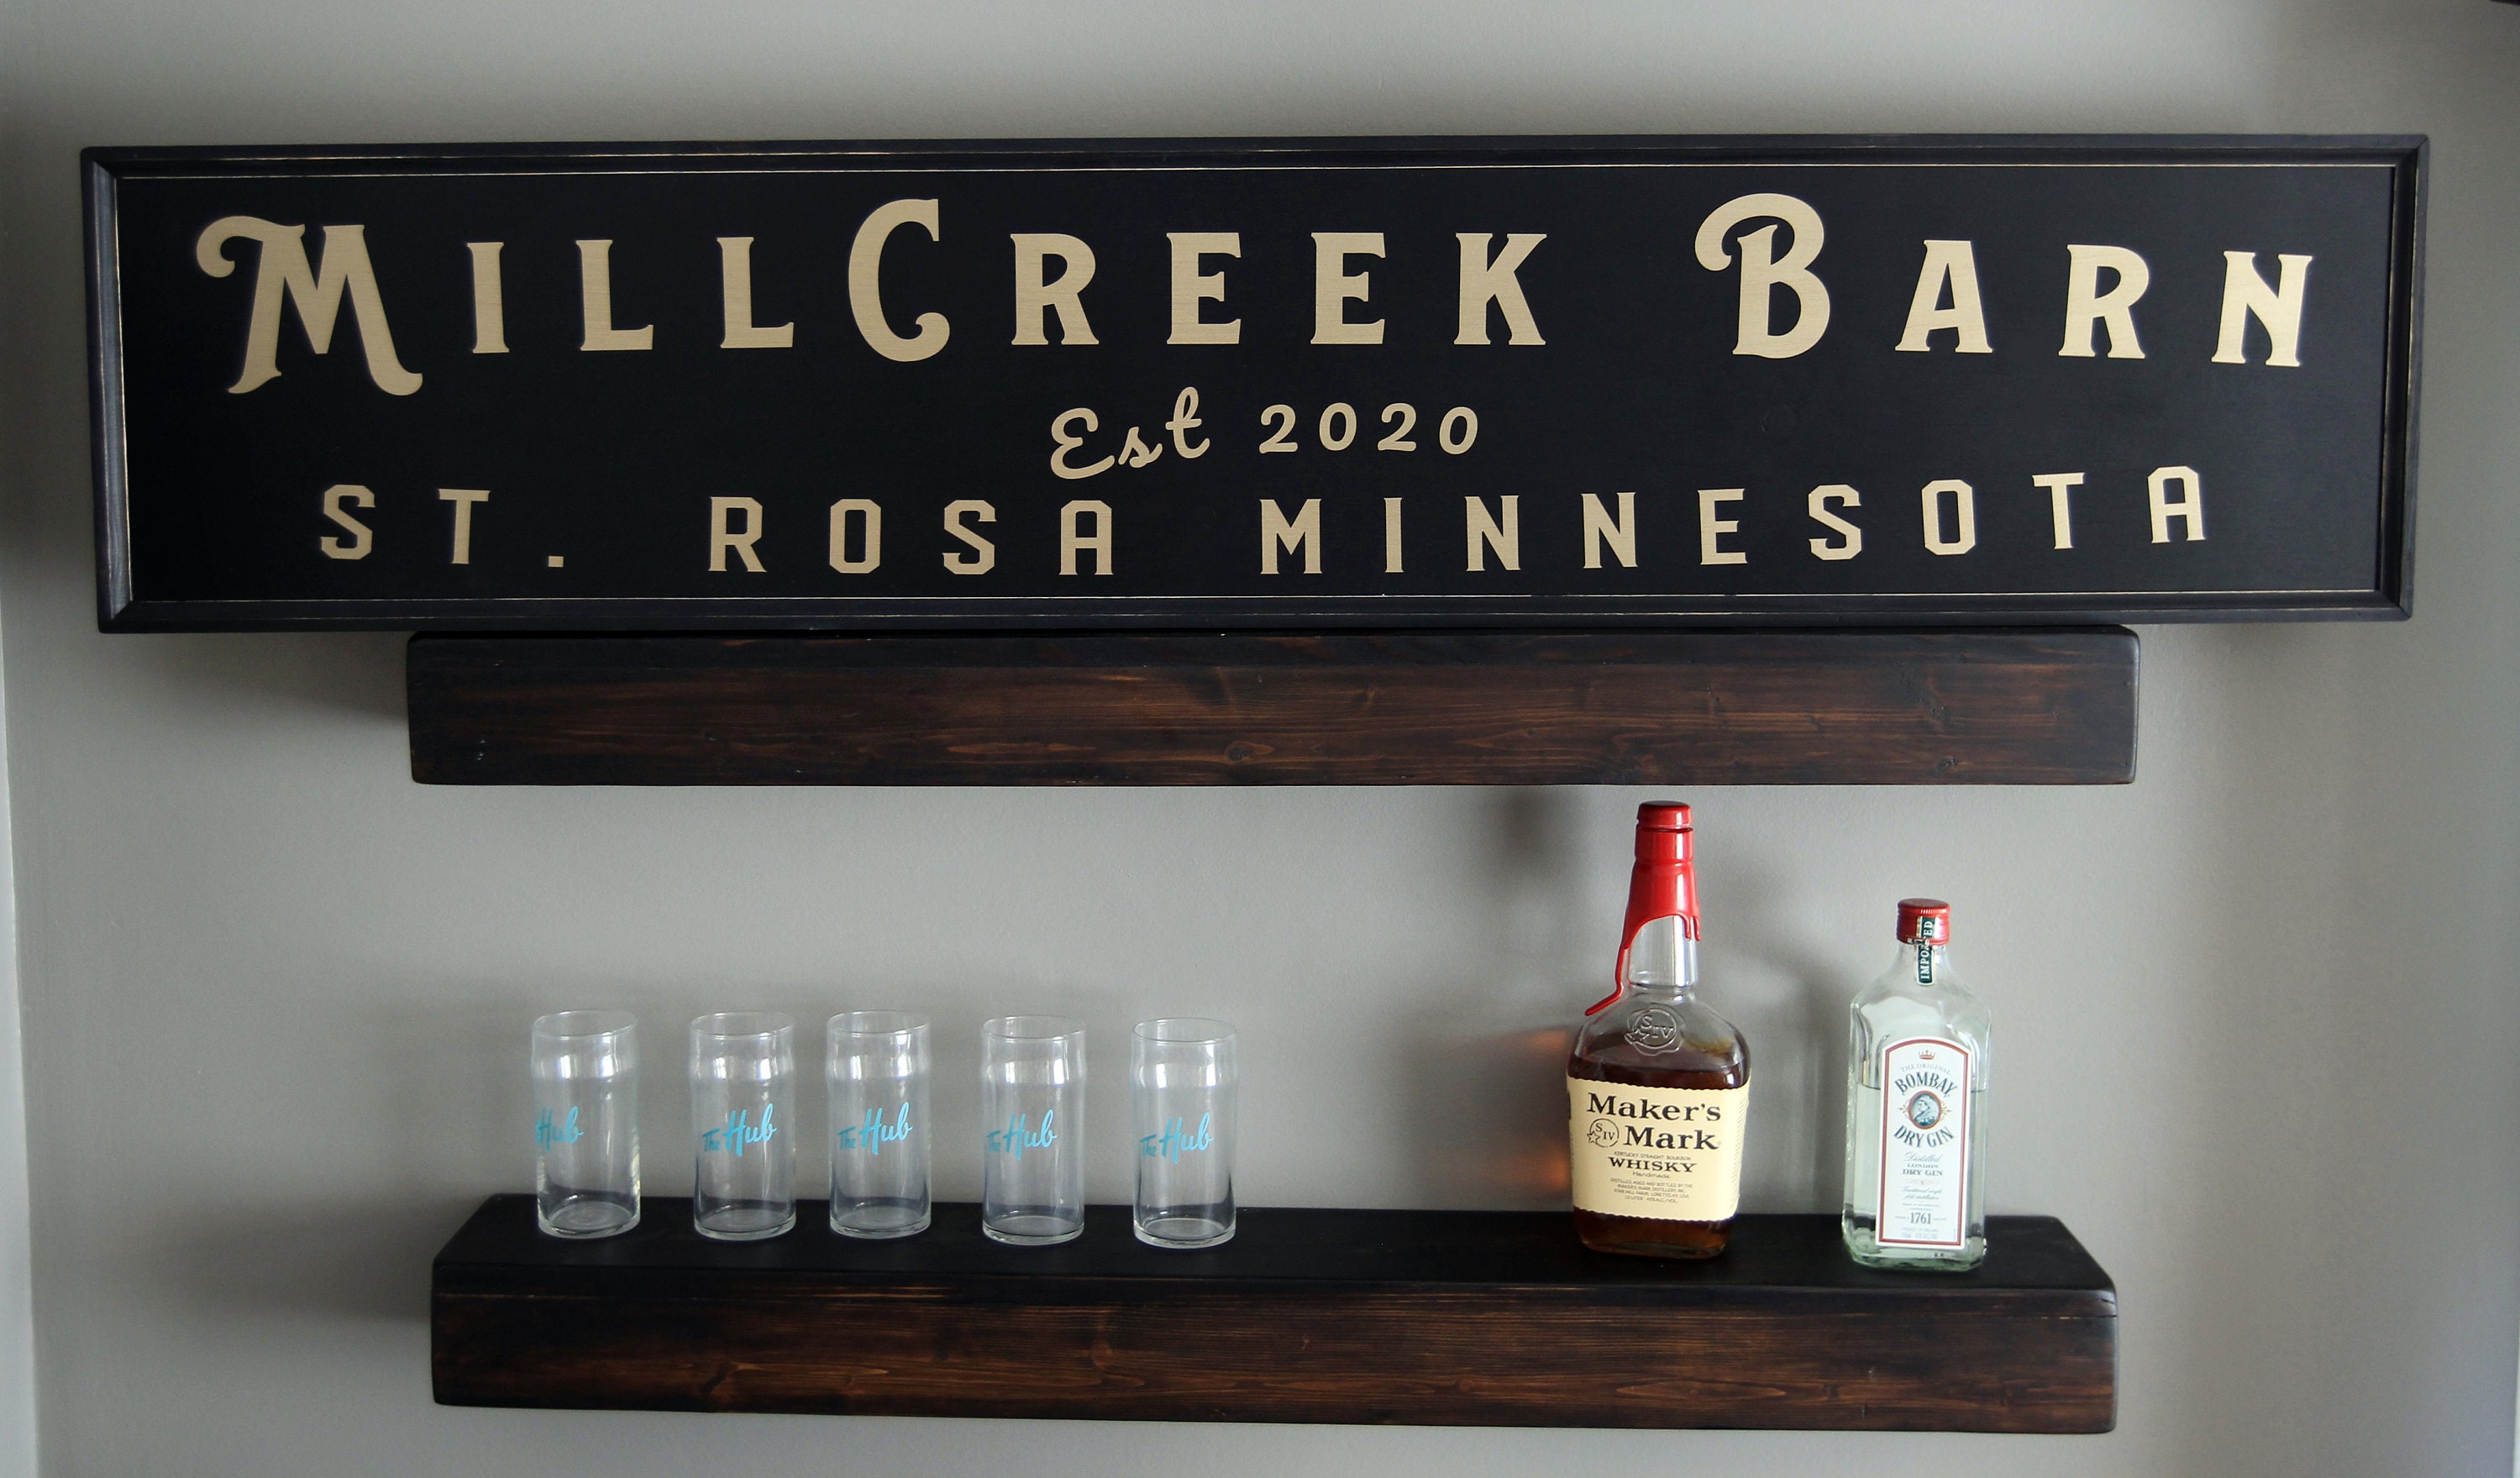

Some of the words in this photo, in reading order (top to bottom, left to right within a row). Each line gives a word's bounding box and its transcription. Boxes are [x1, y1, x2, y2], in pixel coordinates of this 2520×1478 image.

[1050, 386, 1210, 480] Est
[1258, 402, 1478, 455] 2020
[321, 485, 564, 568] ST.
[708, 496, 1114, 575] ROSA
[1259, 465, 2207, 574] MINNESOTA
[1893, 1072, 1958, 1095] BOMBAY
[1916, 1063, 1951, 1075] ORIGINAL
[1587, 1093, 1721, 1122] Maker's
[721, 1103, 778, 1157] Hub
[858, 1102, 914, 1156] Hub
[1002, 1109, 1058, 1161] Hub
[1158, 1112, 1214, 1165] Hub
[1623, 1124, 1719, 1150] Mark
[1893, 1125, 1924, 1148] DRY
[1926, 1126, 1955, 1148] GIN
[1608, 1156, 1697, 1172] WHISKY
[1910, 1212, 1931, 1224] 1761
